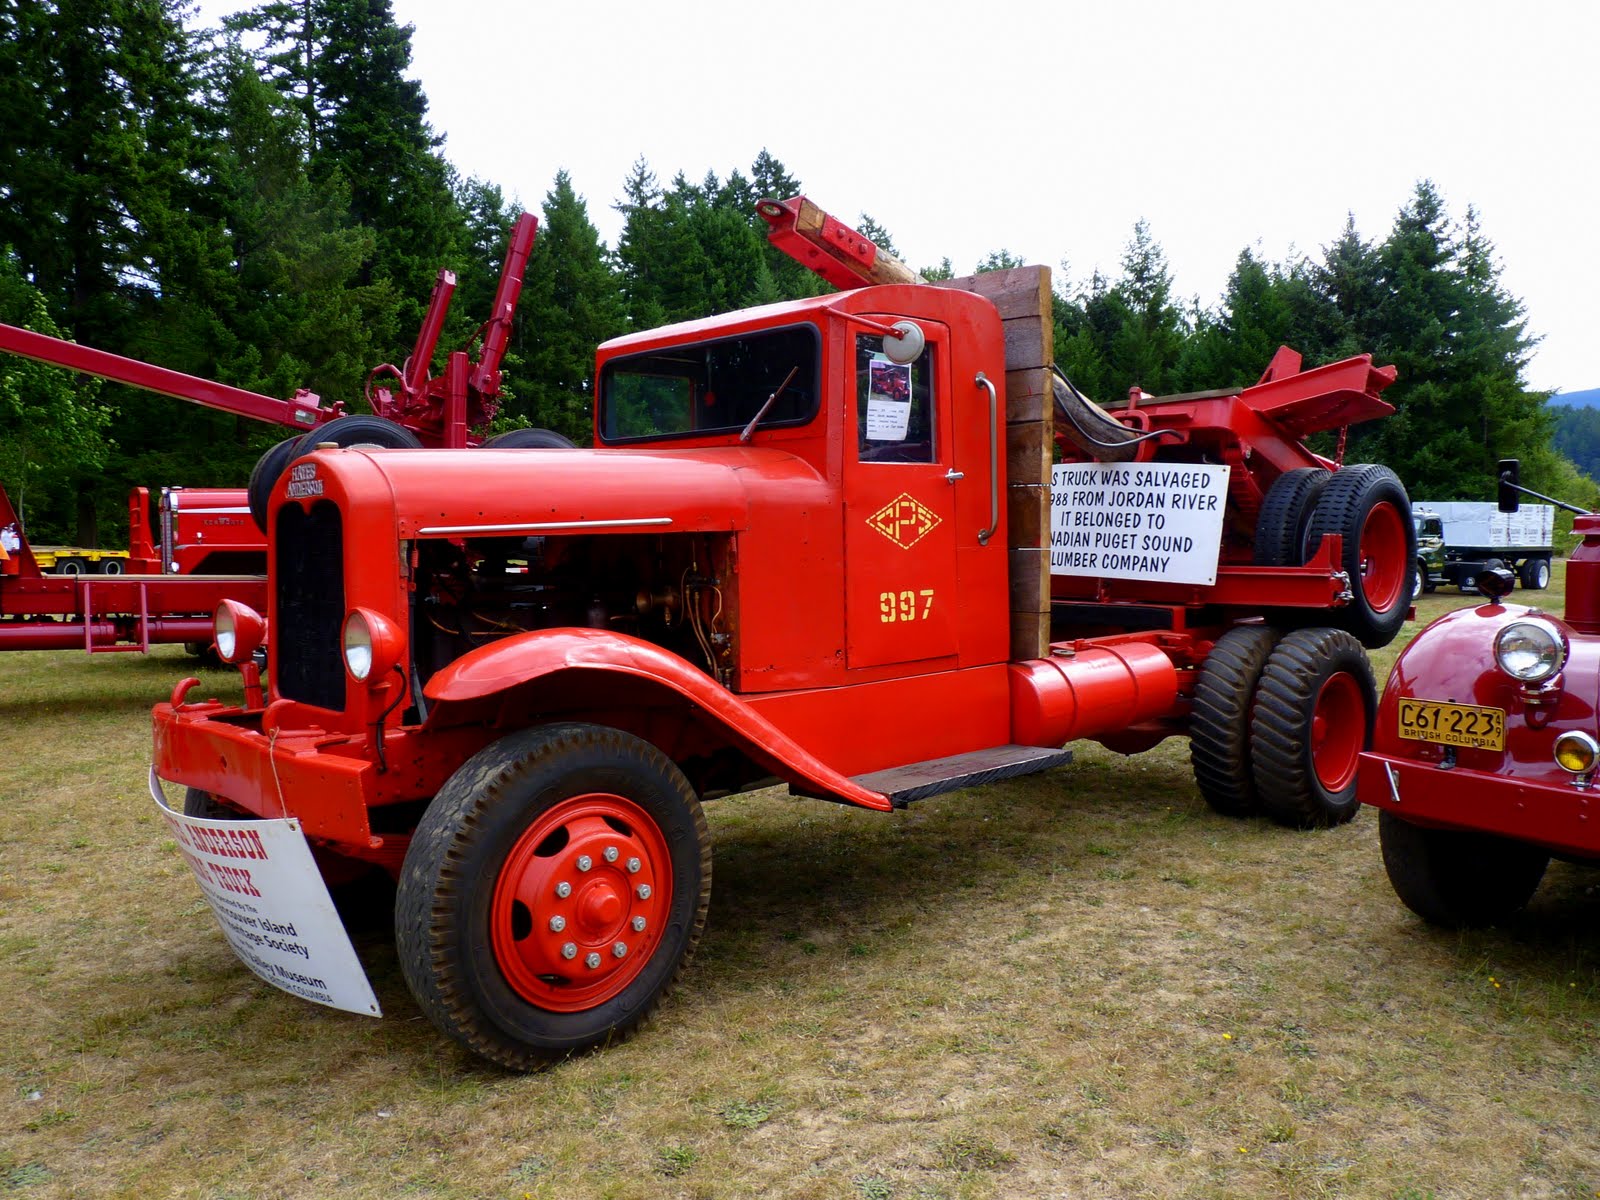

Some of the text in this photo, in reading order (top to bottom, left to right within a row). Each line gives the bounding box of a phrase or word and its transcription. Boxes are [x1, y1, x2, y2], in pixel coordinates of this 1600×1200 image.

[291, 463, 316, 481] HAYES
[1062, 470, 1098, 486] TRUCK
[1101, 470, 1130, 486] WAS
[1134, 471, 1210, 489] SALVAGED
[1050, 491, 1218, 511] 988 FROM JORDAN RIVER
[877, 501, 932, 540] CPS
[1061, 511, 1165, 529] IT BELONGED TO
[1050, 531, 1193, 553] NADIAN PUGET SOUND
[1051, 551, 1170, 573] LUMBER COMPANY
[880, 589, 934, 623] 997
[1404, 729, 1497, 747] BRITISH COLUMBIA
[184, 823, 269, 860] ANDERSON
[207, 862, 262, 897] TRUCK
[257, 917, 297, 937] Island
[263, 935, 309, 960] Society
[275, 964, 328, 990] Museum
[292, 985, 335, 1004] COLUMBIA
